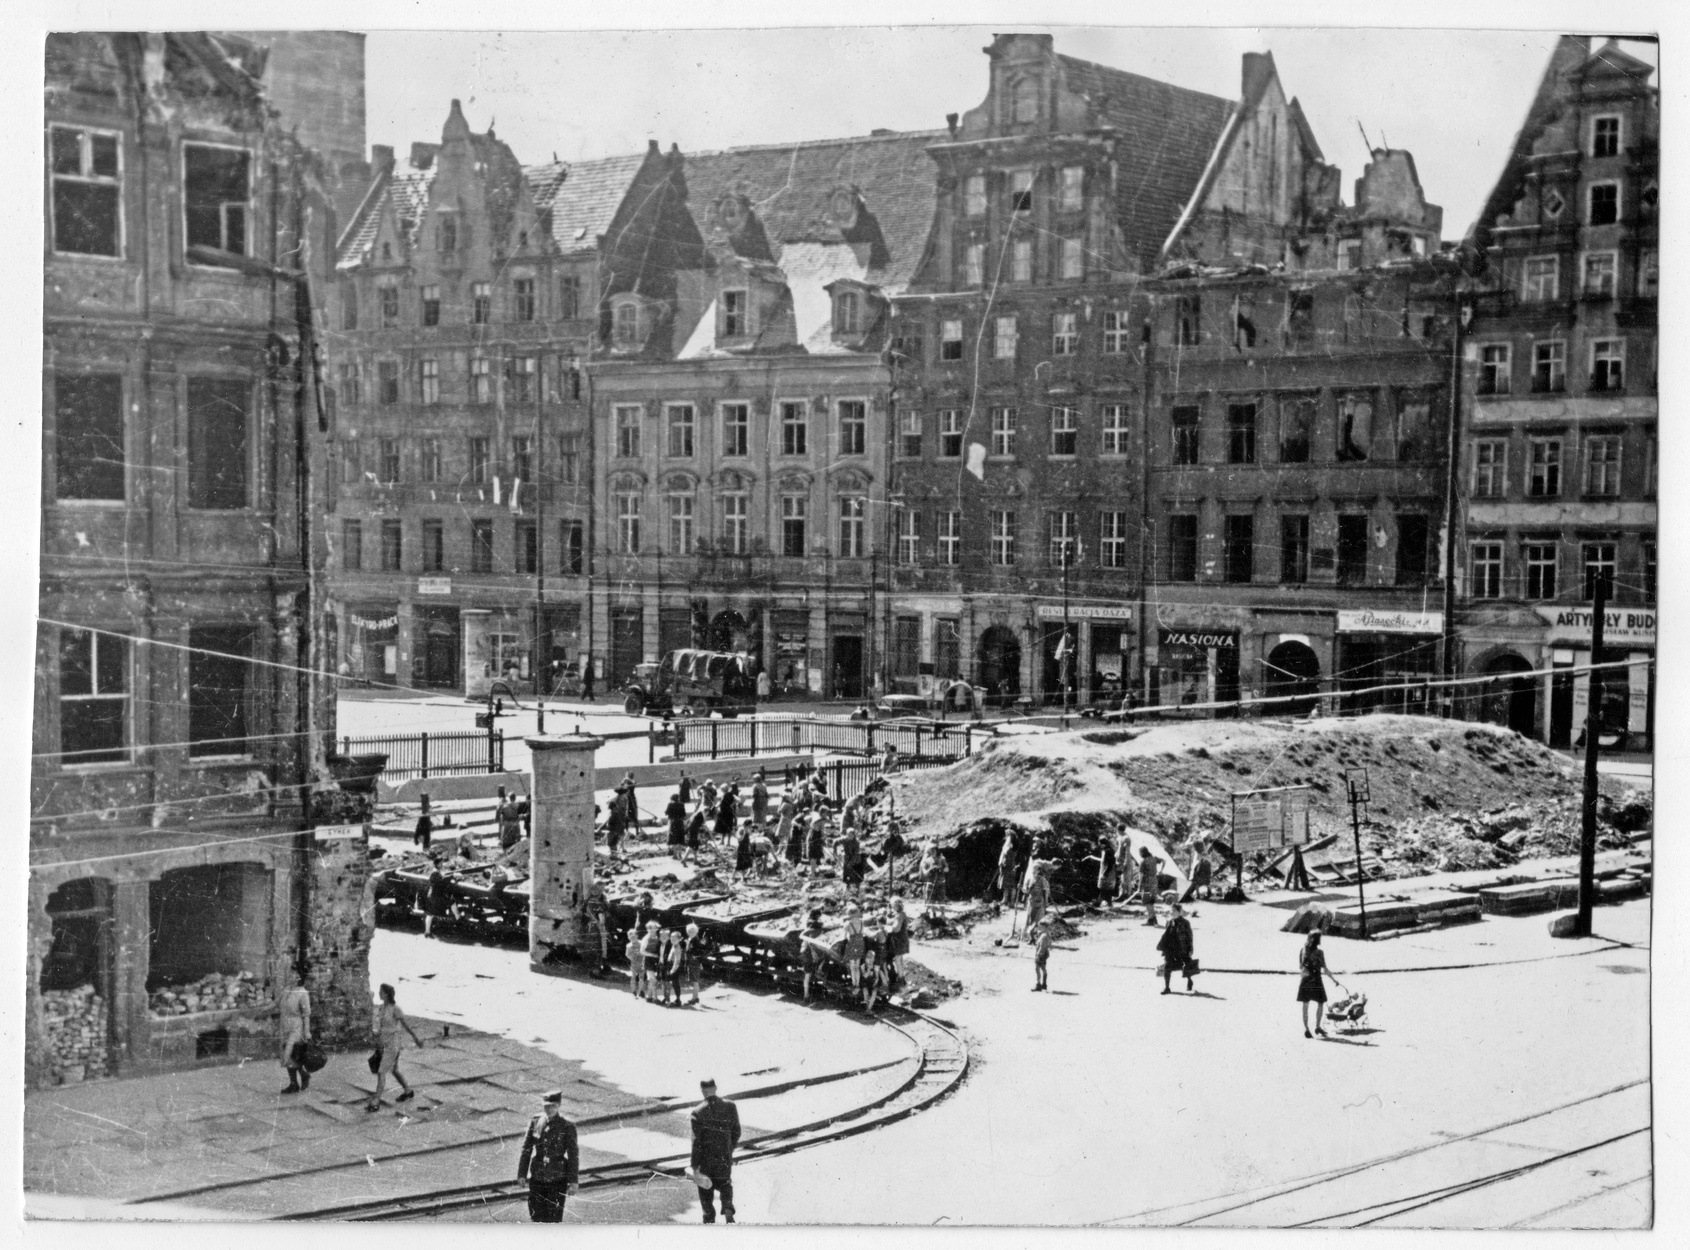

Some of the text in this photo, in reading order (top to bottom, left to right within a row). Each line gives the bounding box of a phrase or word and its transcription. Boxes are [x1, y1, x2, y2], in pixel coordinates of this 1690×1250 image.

[1042, 607, 1100, 616] RESTURACJA
[1556, 612, 1656, 628] ARTYŁY BUD
[1164, 633, 1235, 646] NASIONA
